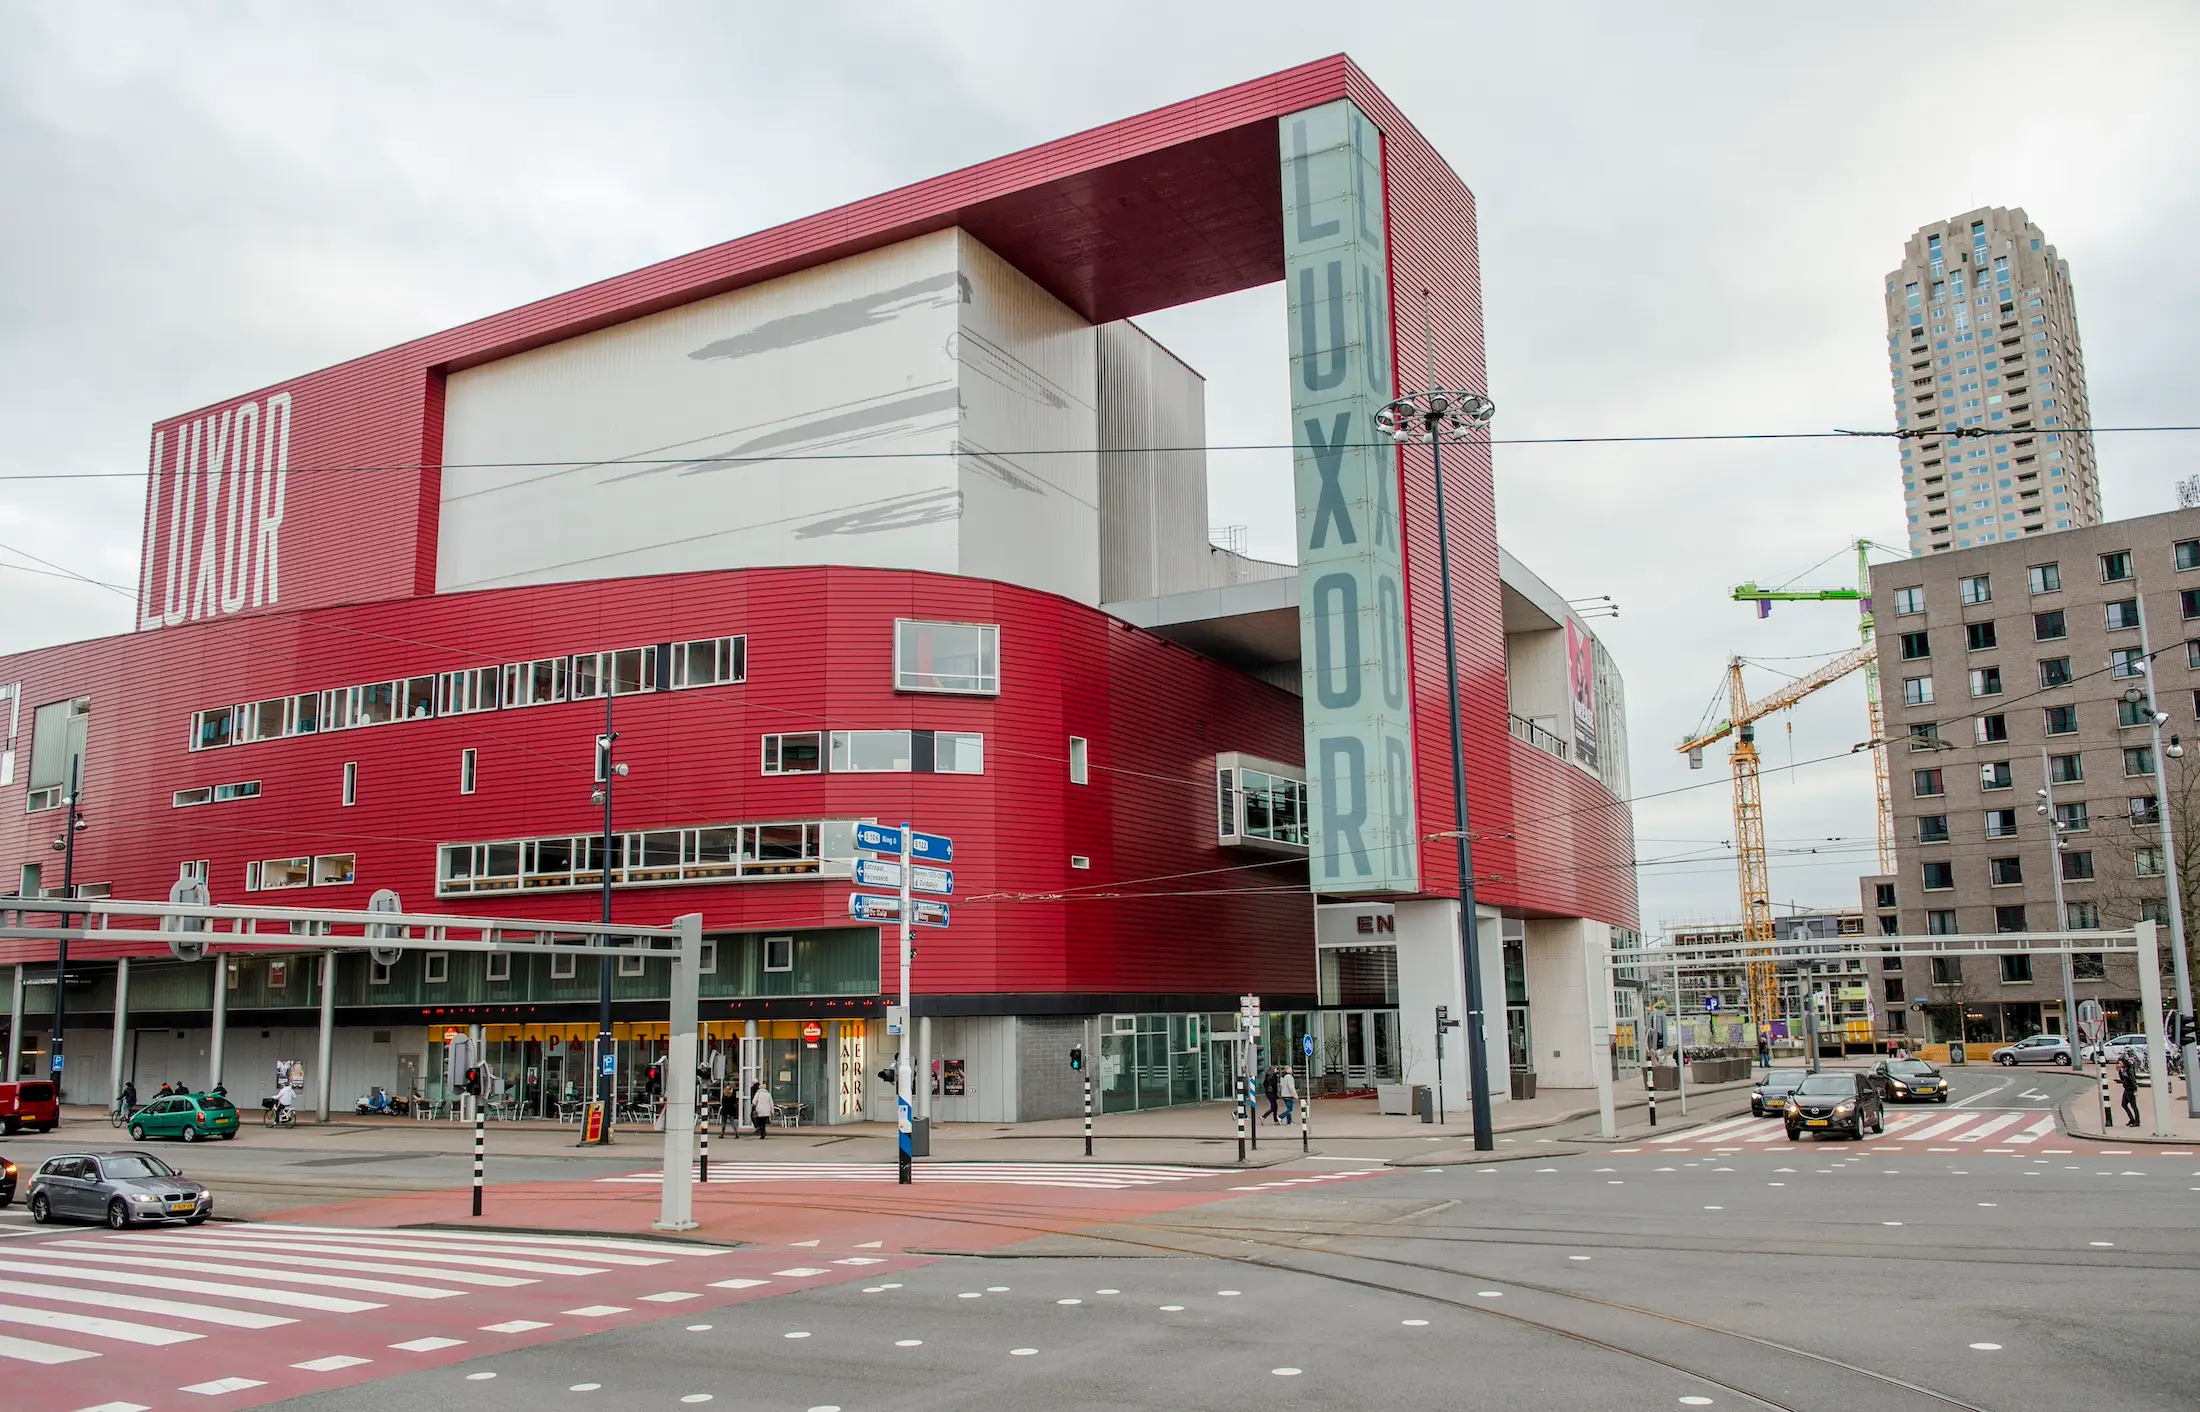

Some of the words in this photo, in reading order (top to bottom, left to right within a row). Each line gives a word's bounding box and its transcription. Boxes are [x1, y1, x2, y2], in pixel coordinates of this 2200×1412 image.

[140, 391, 294, 631] LUXOR
[1292, 119, 1372, 878] LUXOR
[1354, 114, 1413, 878] LUXOR
[508, 1034, 583, 1052] TAPA
[636, 1032, 739, 1051] TERA
[840, 1026, 850, 1115] TAPAS
[853, 1026, 862, 1112] TERRA
